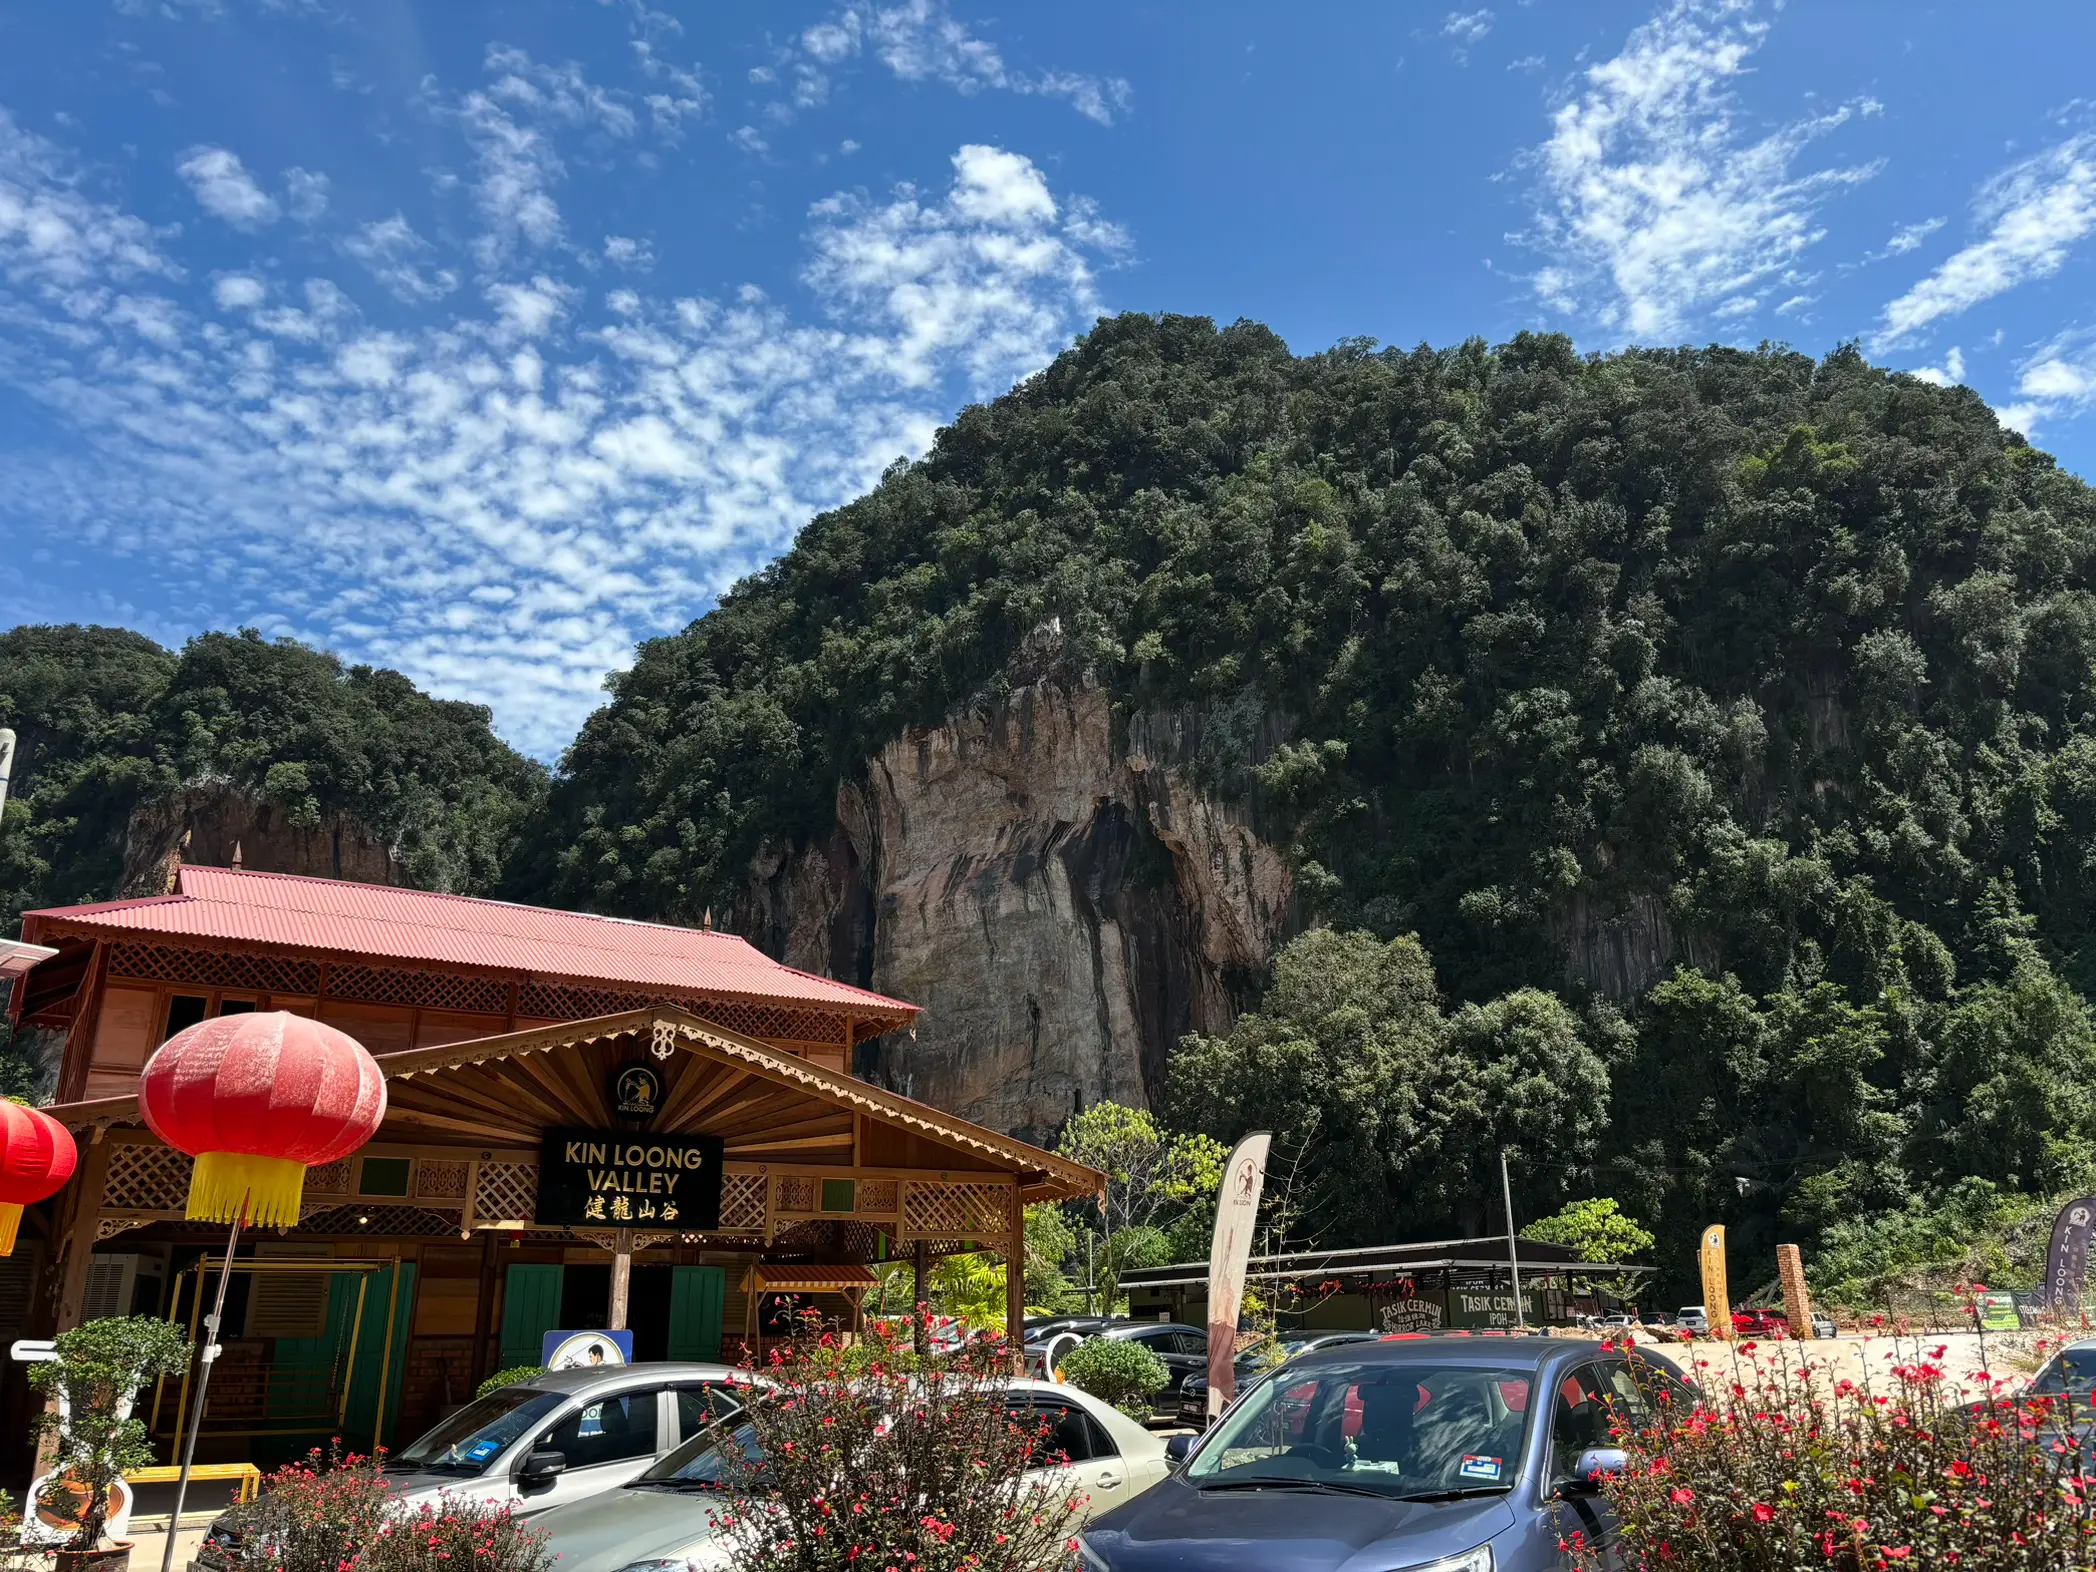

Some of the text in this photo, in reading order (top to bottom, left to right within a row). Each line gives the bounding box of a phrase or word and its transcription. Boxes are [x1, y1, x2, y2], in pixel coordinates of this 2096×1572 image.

[565, 1142, 702, 1169] KIN LOONG
[587, 1169, 680, 1194] VALLEY
[584, 1195, 680, 1221] 健龍山谷
[2054, 1226, 2073, 1305] KIN LOONG
[1380, 1301, 1407, 1319] TASIK
[1460, 1294, 1533, 1313] TASIK CERIN
[1709, 1278, 1718, 1318] LOONG
[1415, 1320, 1431, 1329] LAKE
[1489, 1312, 1508, 1325] IPOH
